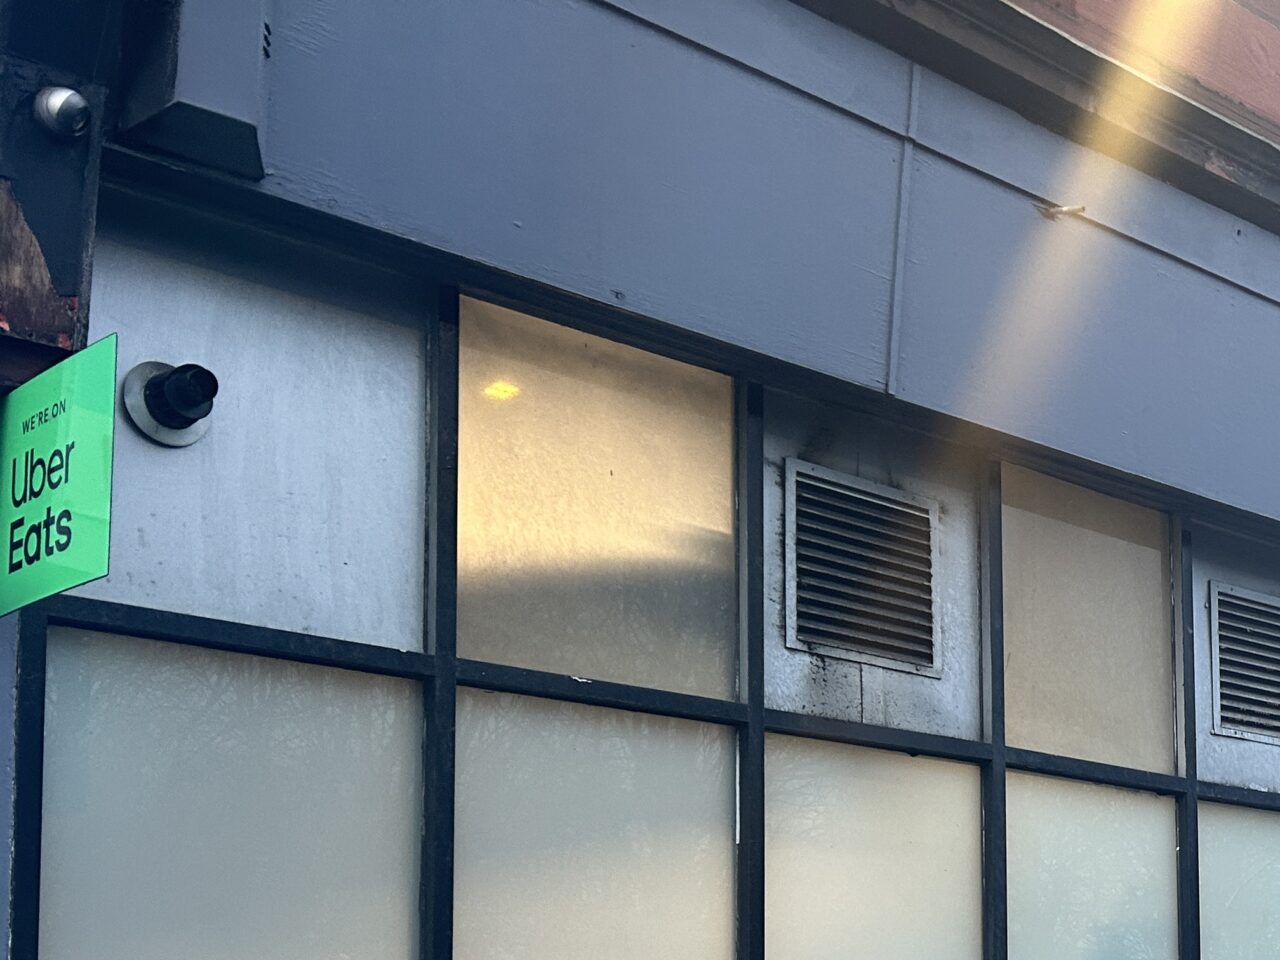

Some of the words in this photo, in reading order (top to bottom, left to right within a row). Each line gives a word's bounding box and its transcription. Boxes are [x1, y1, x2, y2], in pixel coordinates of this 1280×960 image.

[22, 407, 49, 435] WE'RE
[51, 397, 67, 418] ON
[11, 440, 75, 508] Uber
[8, 506, 72, 575] Eats
